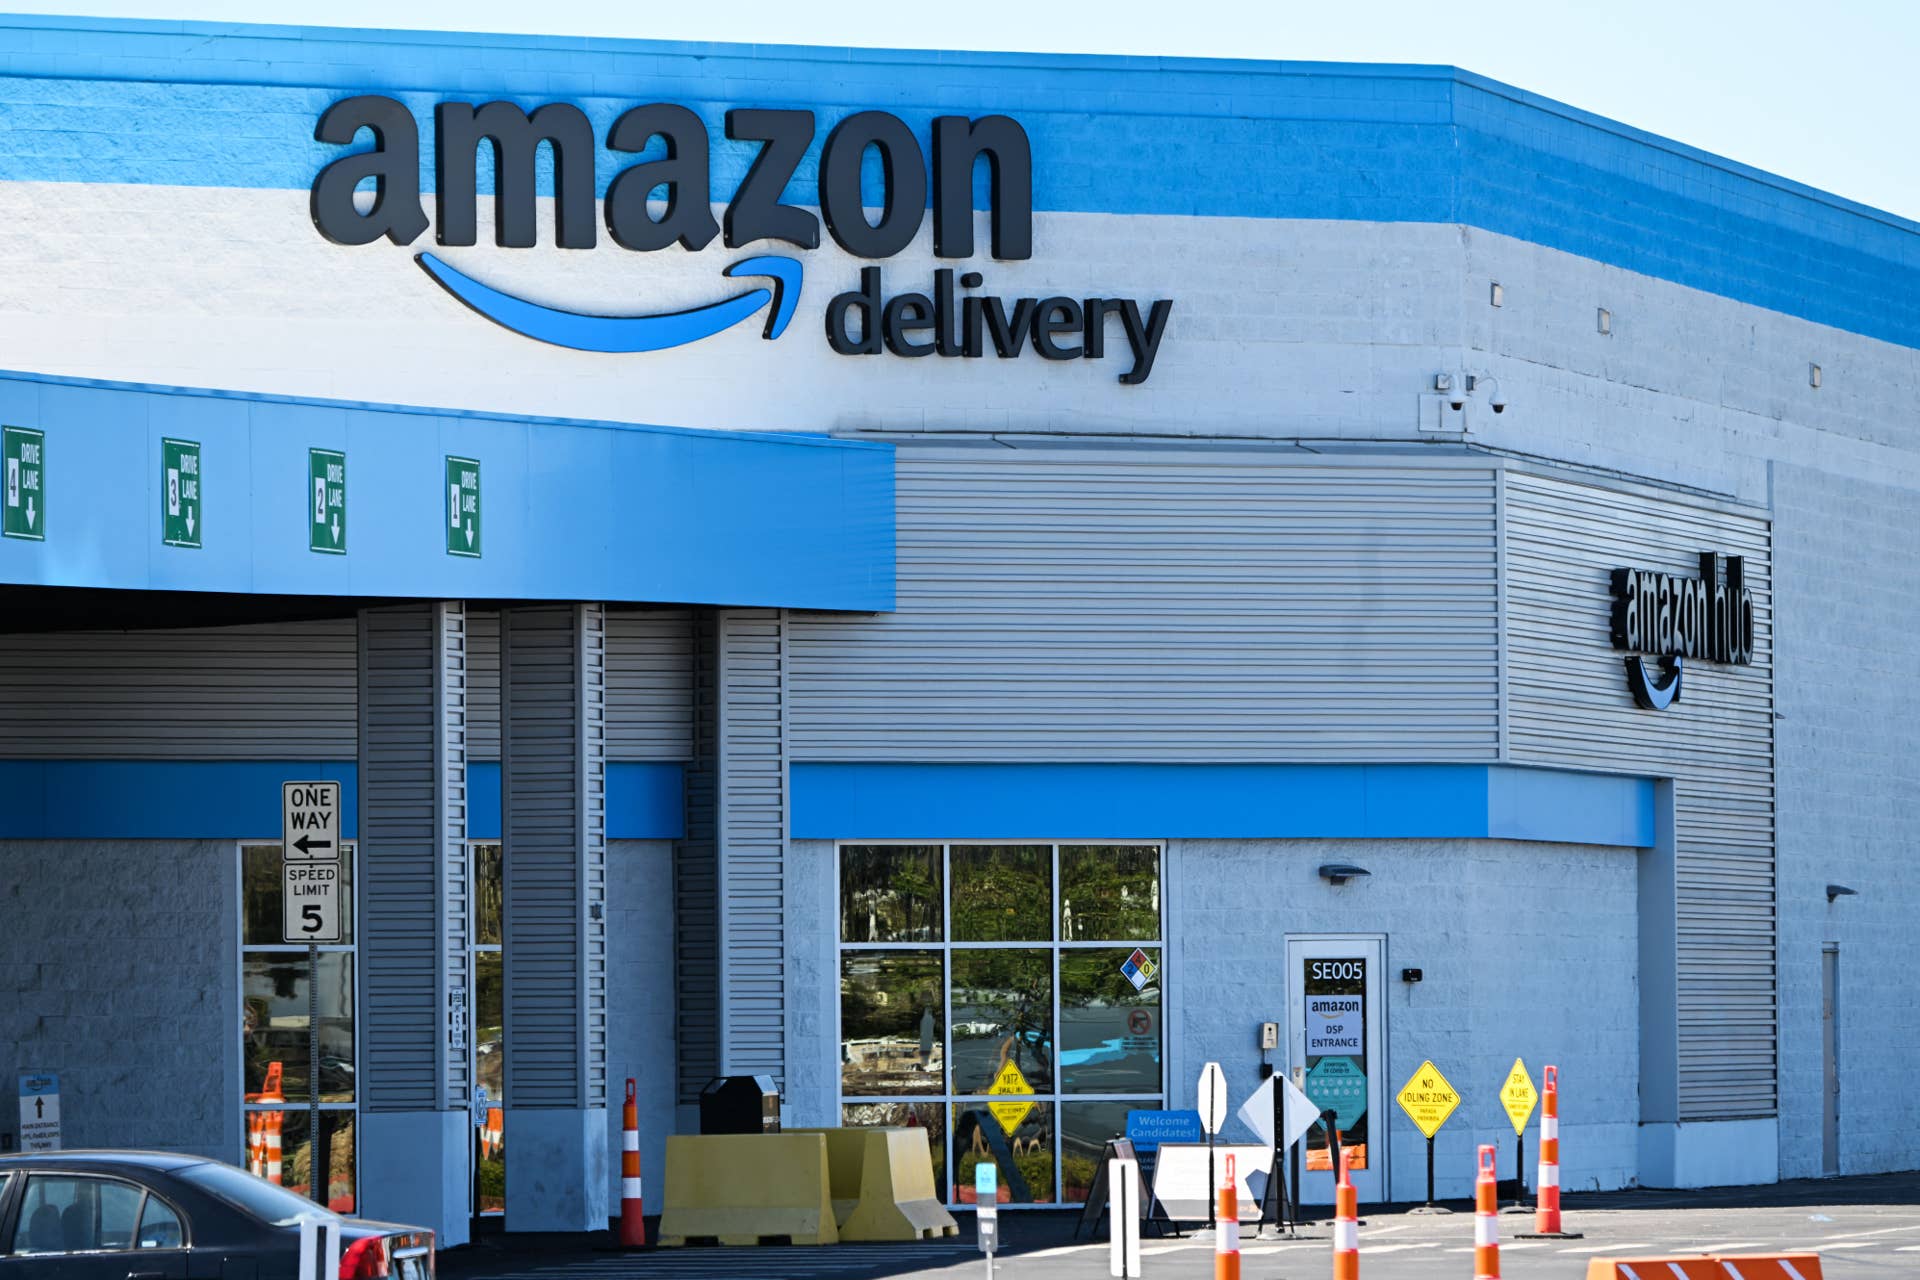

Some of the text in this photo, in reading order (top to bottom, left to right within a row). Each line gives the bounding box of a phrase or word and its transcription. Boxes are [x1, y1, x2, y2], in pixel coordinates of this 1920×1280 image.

[309, 95, 1033, 259] amazon
[825, 266, 1173, 386] delivery
[21, 442, 40, 464] DRIVE
[180, 453, 198, 475] DRIVE
[327, 463, 343, 484] DRIVE
[10, 468, 17, 497] 4
[22, 468, 39, 491] LANE
[182, 479, 198, 500] LANE
[461, 470, 477, 490] DRIVE
[170, 478, 177, 507] 3
[317, 487, 324, 515] 2
[328, 487, 343, 508] LANE
[453, 493, 458, 520] 1
[462, 493, 476, 513] LANE
[1615, 551, 1754, 665] amazon hub
[291, 788, 332, 807] ONE
[291, 811, 332, 830] WAY
[288, 869, 335, 881] SPEED
[293, 884, 331, 896] LIMIT
[301, 904, 323, 933] 5
[1143, 964, 1150, 974] 0
[1312, 961, 1363, 980] SE005
[1311, 999, 1359, 1013] amazon
[1325, 1025, 1344, 1034] DSP
[1311, 1038, 1358, 1048] ENTRANCE
[1422, 1079, 1434, 1089] NO
[1515, 1087, 1529, 1098] LANE
[1404, 1092, 1453, 1103] IDLING ZONE
[1139, 1116, 1190, 1126] Welcome
[1131, 1127, 1196, 1137] Candidates!
